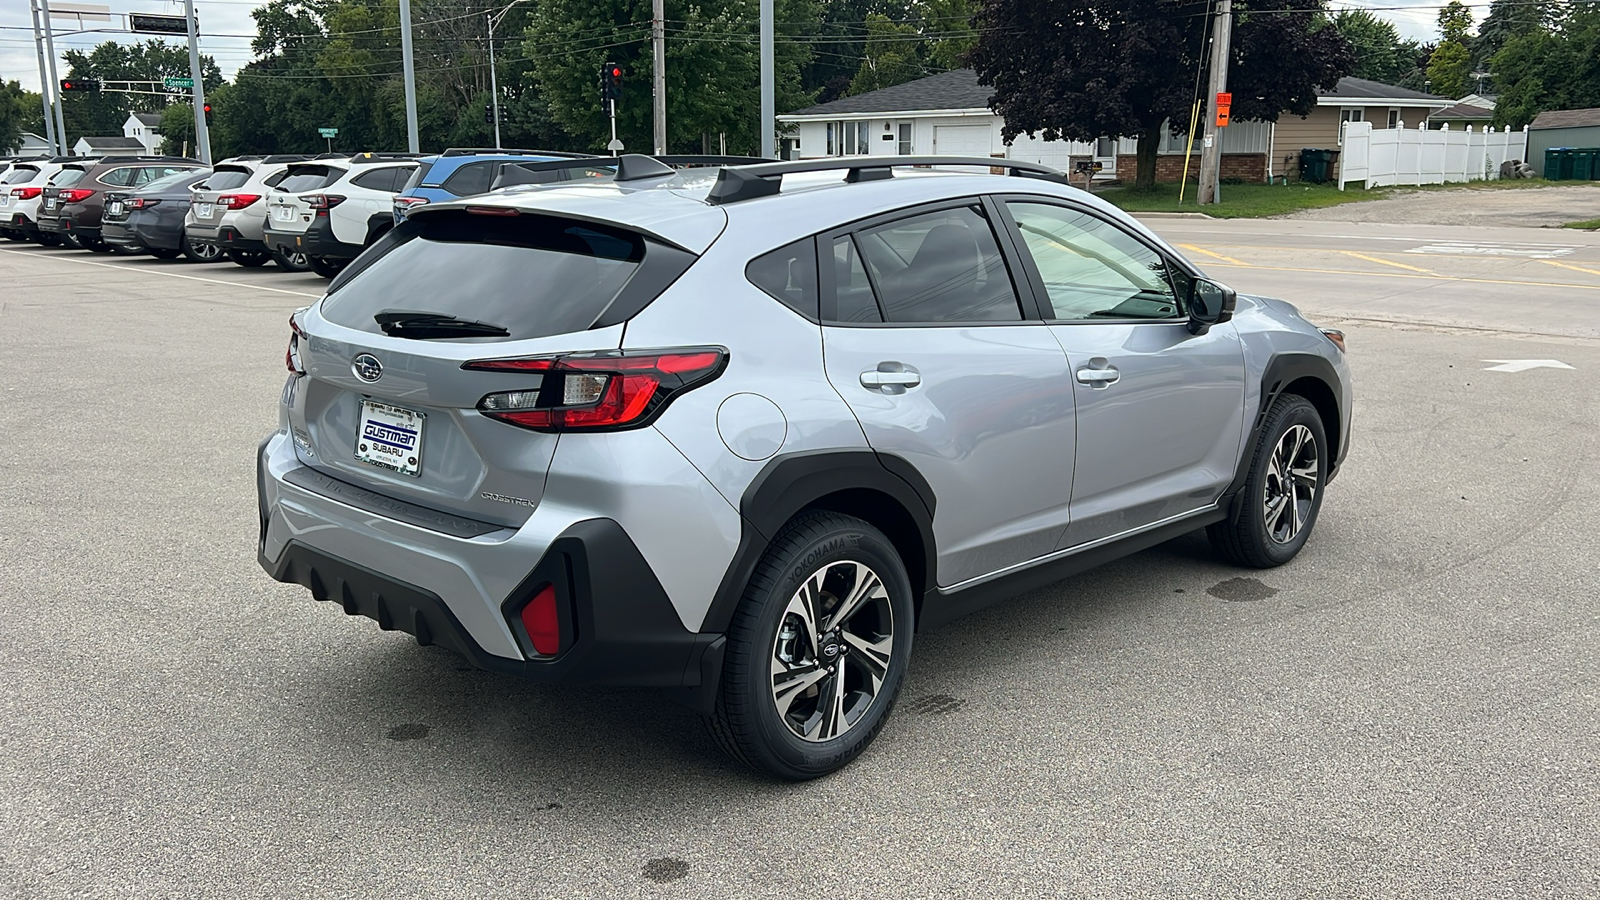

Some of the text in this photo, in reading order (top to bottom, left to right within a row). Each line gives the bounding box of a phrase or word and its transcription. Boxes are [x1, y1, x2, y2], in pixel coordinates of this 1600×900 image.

[169, 79, 190, 87] Spencer
[372, 442, 404, 458] SUBARU
[481, 491, 535, 508] CROSSTREK
[787, 537, 846, 583] YOKOHAMA
